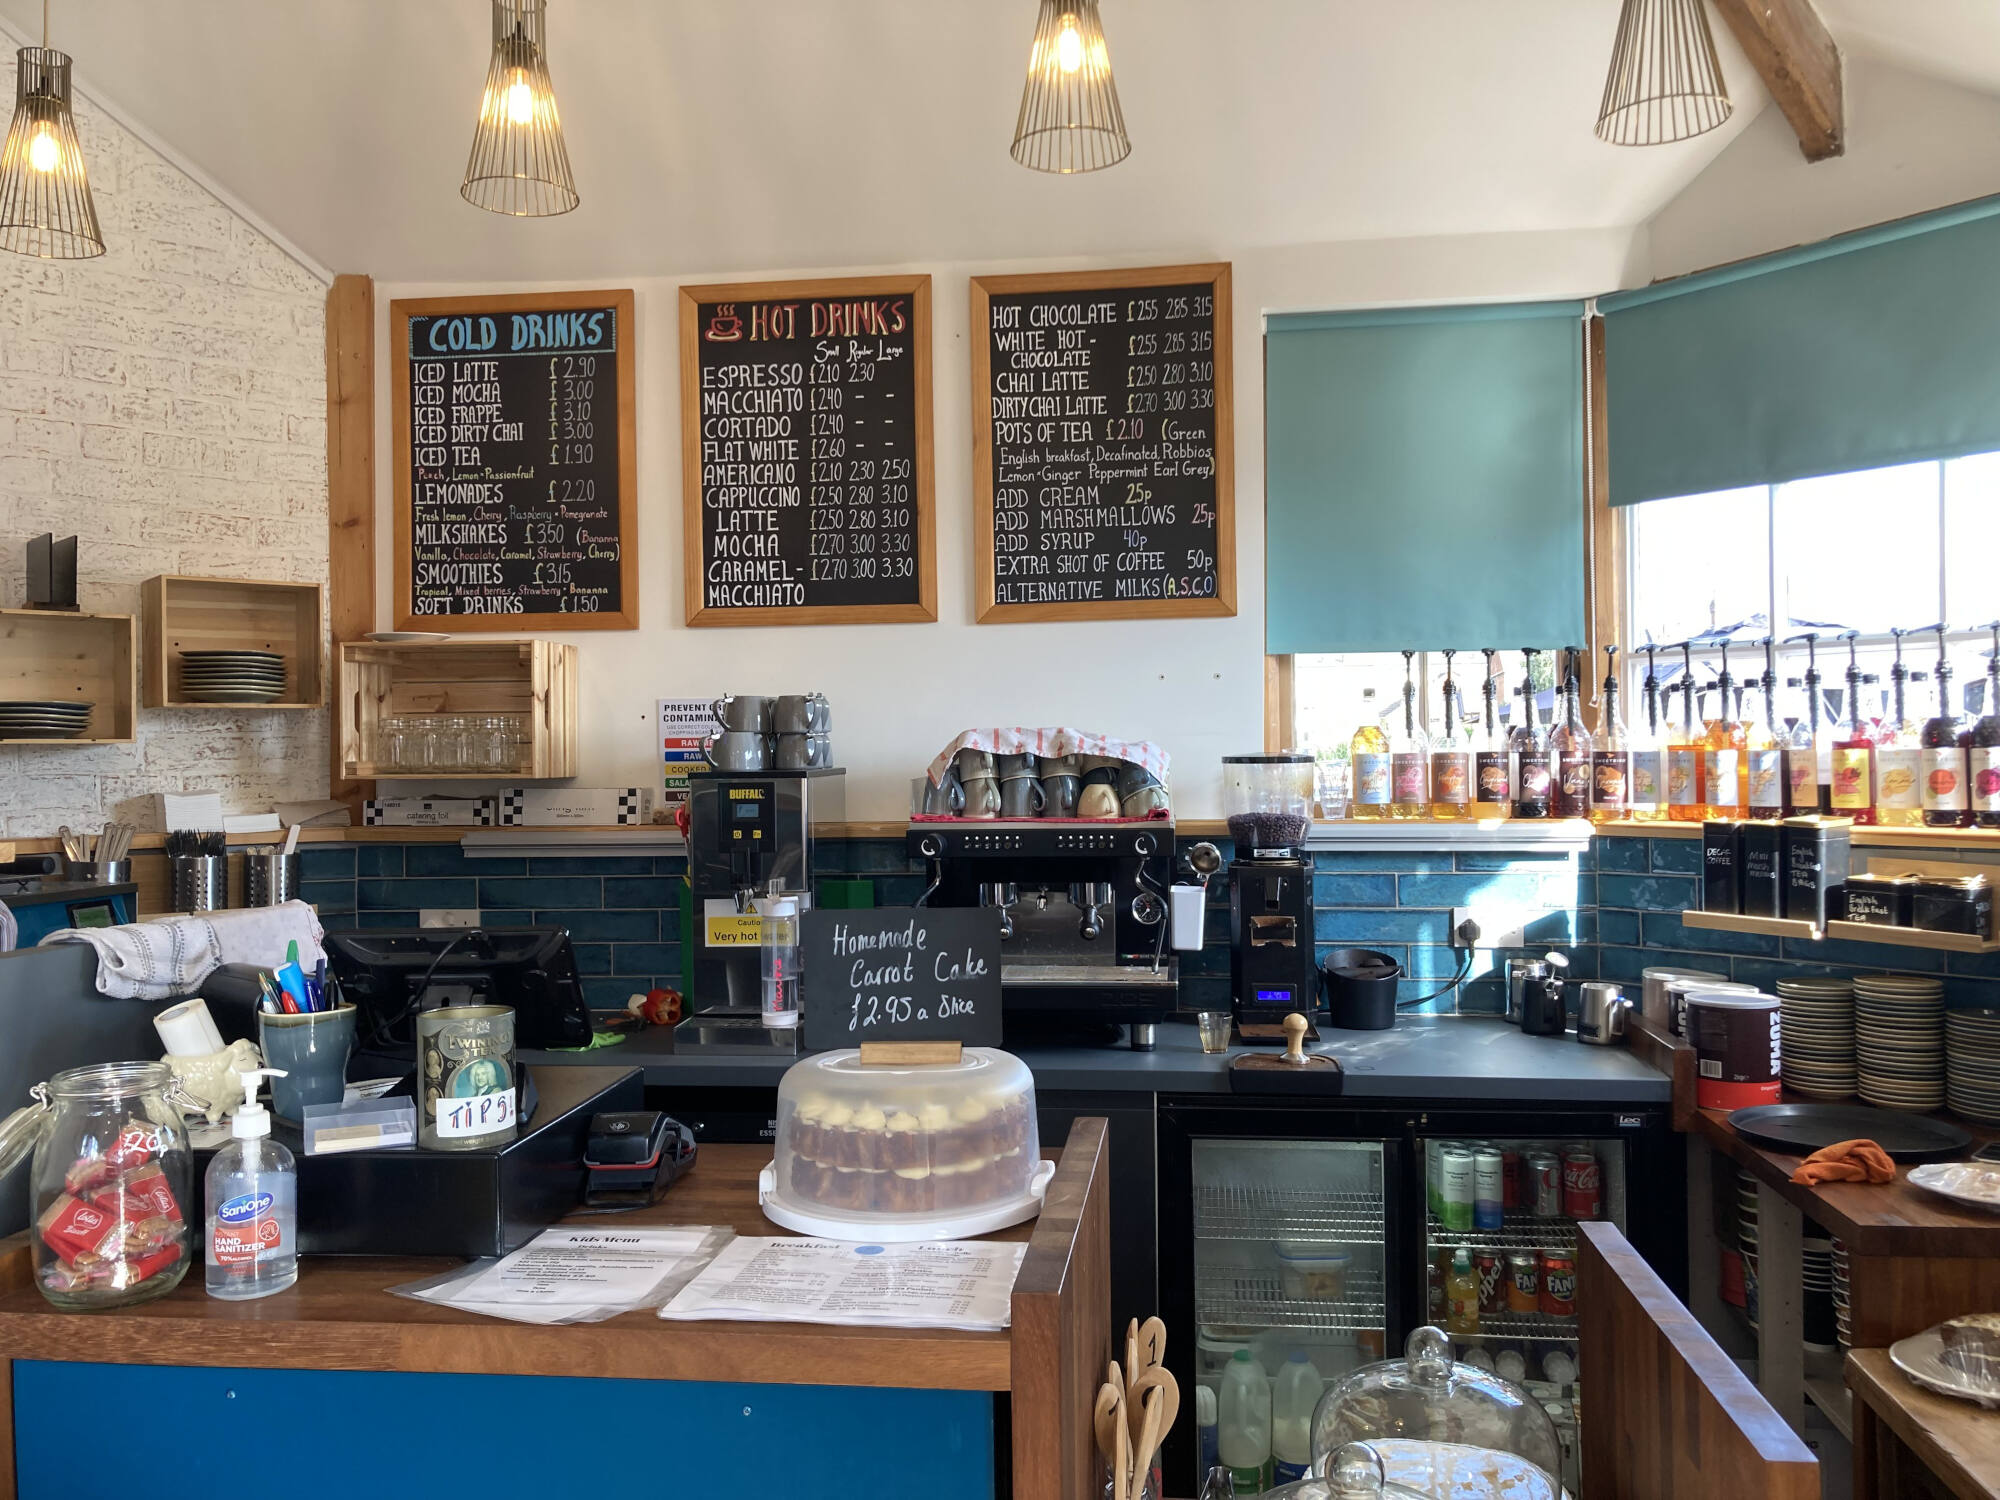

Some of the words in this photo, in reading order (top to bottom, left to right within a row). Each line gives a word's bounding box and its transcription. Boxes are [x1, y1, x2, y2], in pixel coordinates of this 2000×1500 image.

[750, 305, 799, 341] HOT
[810, 301, 906, 337] DRINKS
[993, 306, 1021, 329] HOT
[1030, 303, 1116, 327] CHOCOLATE
[429, 317, 497, 352] COLD
[511, 313, 604, 350] DRINKS
[995, 331, 1045, 351] WHITE
[877, 339, 903, 361] Large
[1011, 351, 1090, 369] CHOCOLATE
[415, 364, 445, 383] ICED
[453, 362, 498, 382] LATTE
[703, 363, 803, 388] ESPRESSO
[997, 373, 1034, 393] CHAI
[1042, 371, 1089, 391] LATTE
[1190, 361, 1213, 383] 3.10
[415, 386, 445, 405] ICED
[452, 383, 501, 403] MOCHA
[704, 388, 803, 415] MACCHIATO
[992, 397, 1028, 418] DIRTY
[1029, 397, 1060, 417] CHAI
[1066, 396, 1107, 415] LATTE
[1191, 389, 1214, 409] 3.30
[415, 408, 445, 424] ICED
[453, 404, 503, 423] FRAPPE
[415, 425, 447, 444] ICED
[451, 425, 488, 442] DIRTY
[493, 423, 523, 440] CHAI
[705, 416, 791, 438] CORTADO
[996, 422, 1032, 445] POTS
[1038, 422, 1055, 442] OF
[1060, 421, 1093, 442] TEA
[415, 448, 447, 466] ICED
[452, 447, 481, 466] TEA
[704, 441, 744, 462] FLAT
[749, 440, 799, 460] WHITE
[1001, 447, 1039, 469] English
[453, 470, 479, 481] Lemon
[484, 466, 534, 480] Passionfruit
[703, 463, 795, 486] AMERICANO
[999, 467, 1034, 483] Lemon
[1042, 466, 1082, 485] Ginger
[1088, 464, 1148, 484] Peppermint
[1154, 461, 1178, 477] Earl
[415, 484, 503, 504] LEMONADES
[707, 487, 800, 508] CAPPUCCINO
[881, 484, 908, 503] 3.10
[995, 489, 1028, 509] ADD
[1040, 486, 1100, 507] CREAM
[1125, 483, 1151, 504] 25p
[415, 507, 439, 522] Fresh
[509, 505, 551, 522] Raspberry
[560, 507, 608, 522] Pomegranate
[716, 510, 779, 532] LATTE
[881, 509, 909, 528] 3.10
[995, 512, 1028, 531] ADD
[1040, 505, 1175, 529] MARSHMALLOWS
[1192, 504, 1215, 528] 25p
[415, 524, 507, 544] MILKSHAKES
[995, 534, 1028, 551] ADD
[1041, 533, 1095, 551] SYRUP
[1124, 530, 1147, 550] 40p
[713, 534, 780, 557] MOCHA
[850, 534, 875, 553] 3.00
[881, 534, 910, 554] 3.30
[851, 559, 876, 579] 3.00
[882, 558, 913, 577] 3.30
[997, 555, 1049, 575] EXTRA
[1058, 555, 1088, 574] SHOT
[1093, 554, 1109, 572] OF
[1117, 552, 1165, 571] COFFEE
[1187, 549, 1212, 572] 50p
[416, 563, 503, 584] SMOOTHIES
[455, 586, 480, 595] Mixed
[519, 585, 560, 596] Strawberry
[570, 583, 608, 594] Bananna
[708, 583, 804, 607] MACCHIATO
[997, 580, 1102, 602] ALTERNATIVE
[1115, 577, 1160, 597] MILKS
[415, 597, 453, 614] SOFT
[463, 596, 523, 613] DRINKS
[664, 704, 706, 712] PREVENT
[407, 812, 436, 822] catering
[439, 812, 448, 820] foil
[1707, 848, 1732, 856] DECAF
[1707, 857, 1732, 865] COFFEE
[714, 932, 738, 942] Very
[741, 932, 758, 941] hot
[833, 919, 926, 956] Homemade
[850, 952, 913, 988] Carrot
[934, 948, 988, 982] Cake
[849, 993, 912, 1031] £2.95
[938, 994, 975, 1019] Slice
[1769, 1011, 1781, 1076] ZUMA
[222, 1197, 270, 1218] SaniOne
[215, 1242, 266, 1252] SANITIZER
[769, 1241, 841, 1250] Breakfast
[1515, 1273, 1537, 1288] FAN
[1547, 1274, 1576, 1291] FANT
[1147, 1333, 1157, 1367] 1
